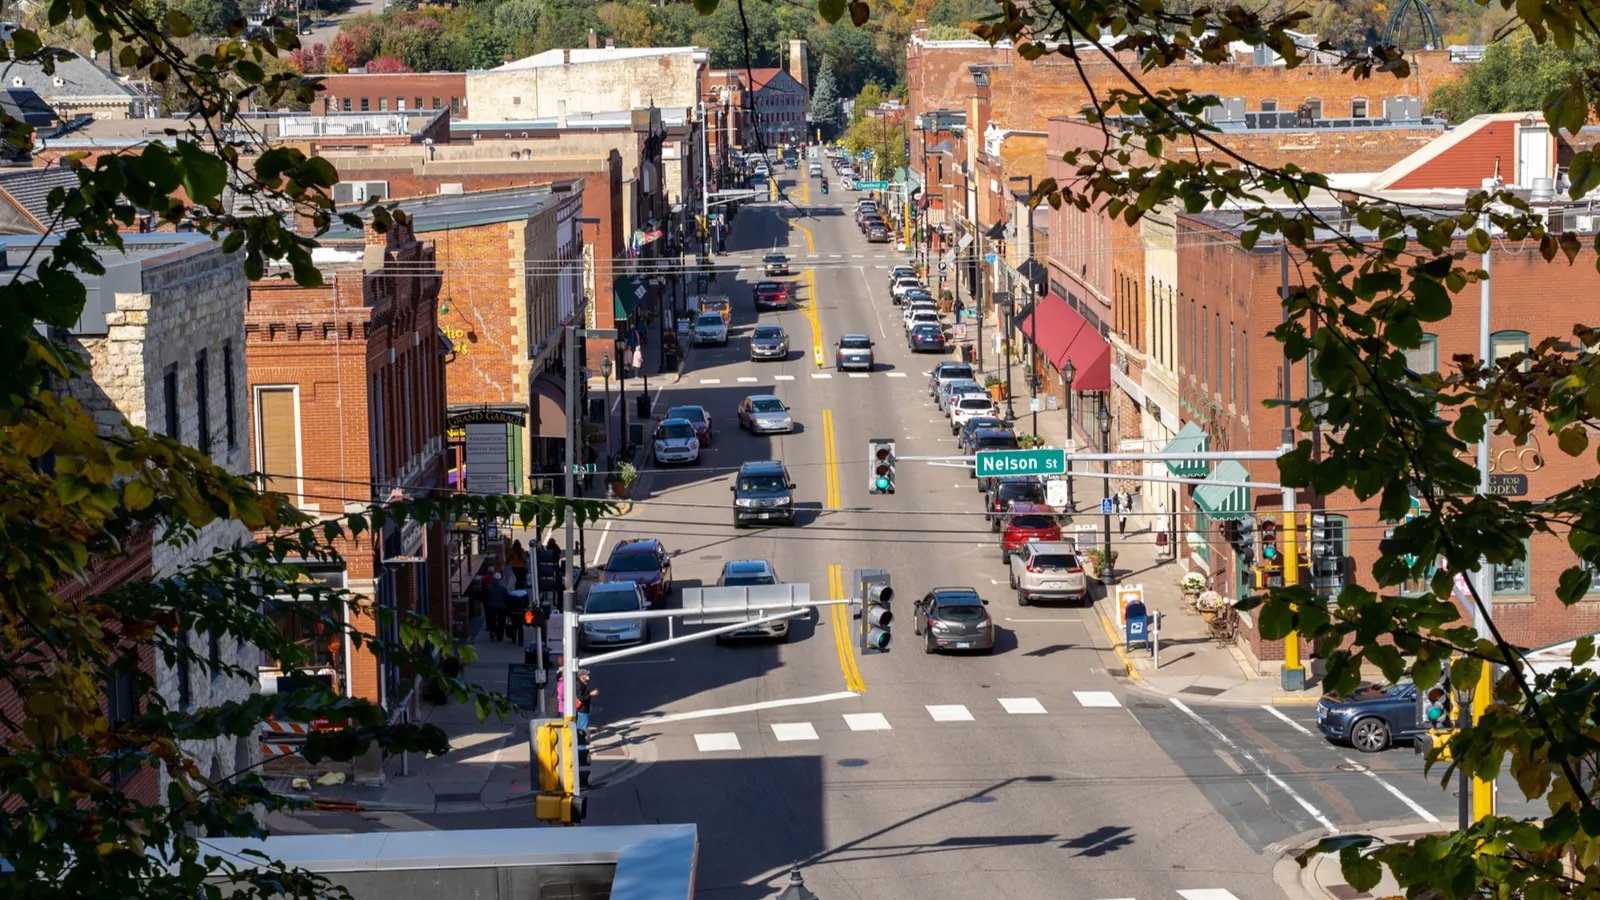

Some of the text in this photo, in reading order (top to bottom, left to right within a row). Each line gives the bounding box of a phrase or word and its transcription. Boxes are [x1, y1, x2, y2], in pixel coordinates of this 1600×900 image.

[448, 412, 523, 425] GRAND GARAGE
[983, 456, 1058, 471] Nelson St
[1503, 477, 1520, 485] FOR
